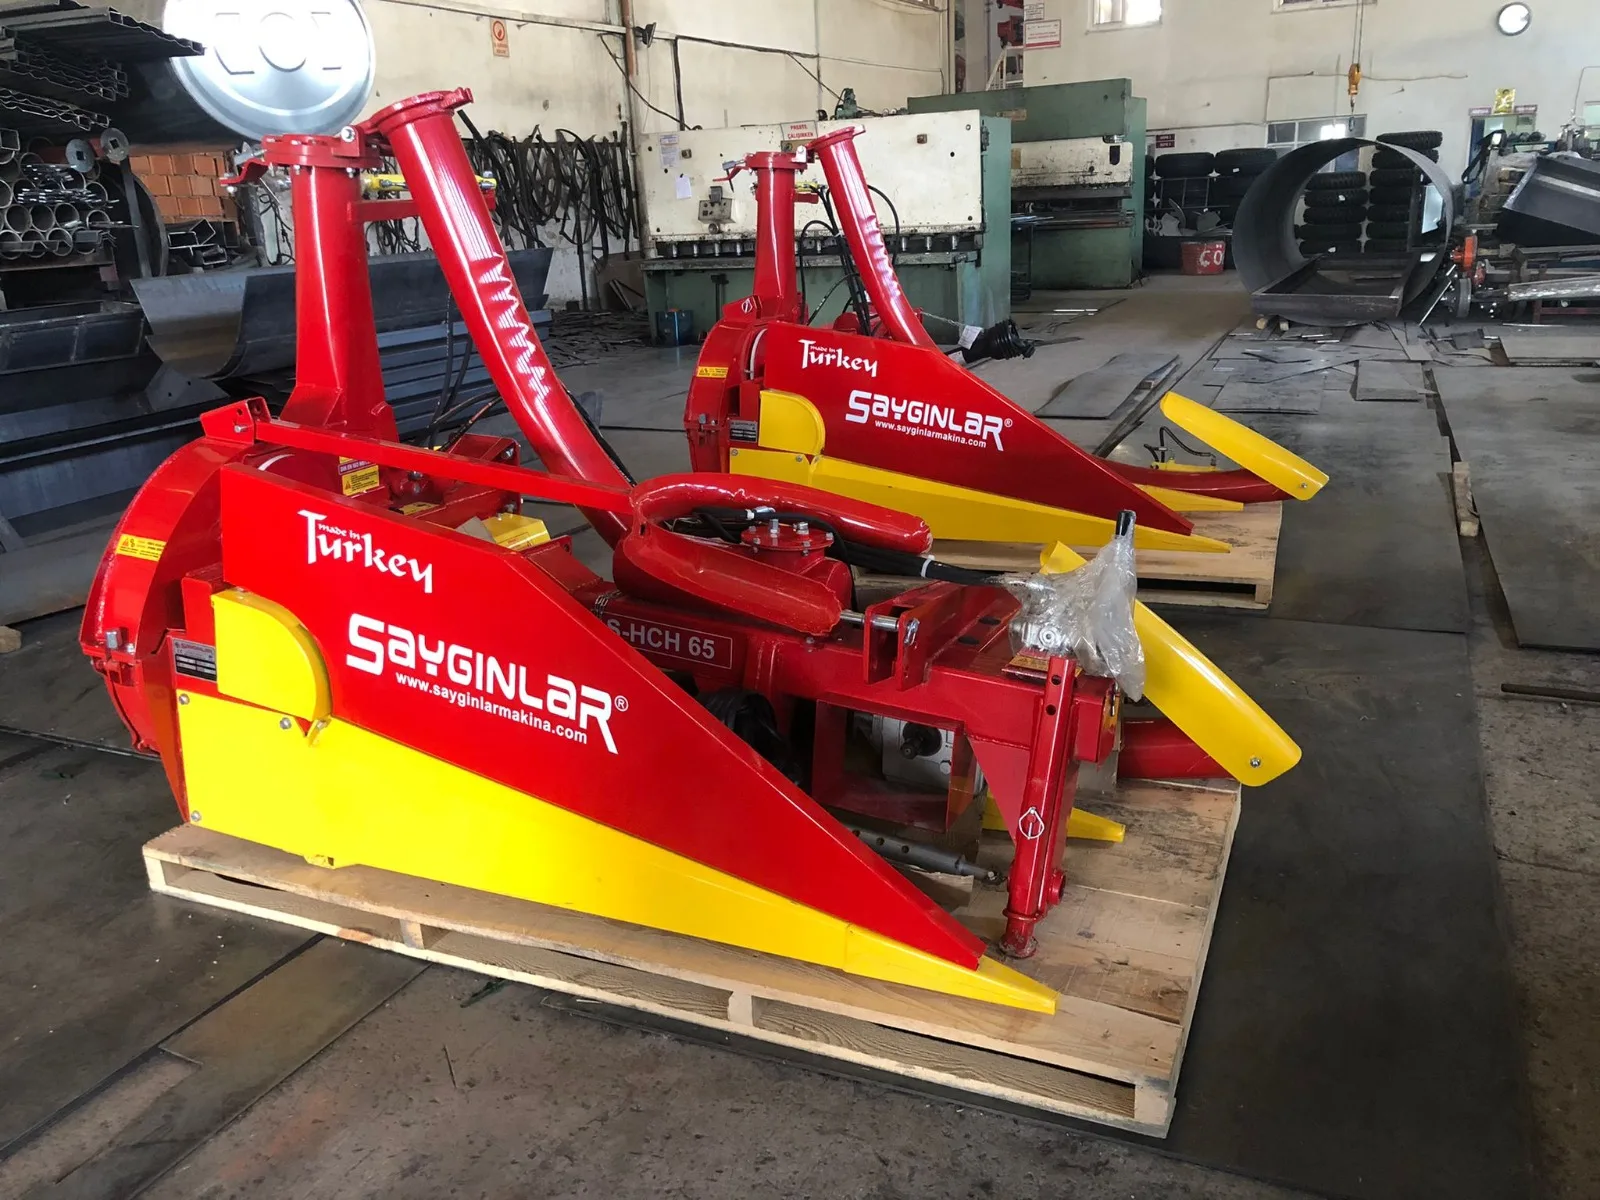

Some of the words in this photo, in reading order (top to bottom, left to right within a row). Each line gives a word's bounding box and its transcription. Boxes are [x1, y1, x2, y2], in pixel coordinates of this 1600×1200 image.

[798, 338, 878, 378] Turkey
[874, 419, 987, 449] www.sayginlarmakina.com
[297, 509, 433, 594] Turkey
[317, 523, 347, 537] made
[349, 529, 361, 540] in
[606, 618, 681, 652] S-HCH
[688, 636, 715, 659] 65
[395, 671, 588, 745] www.sayginlarmakina.com
